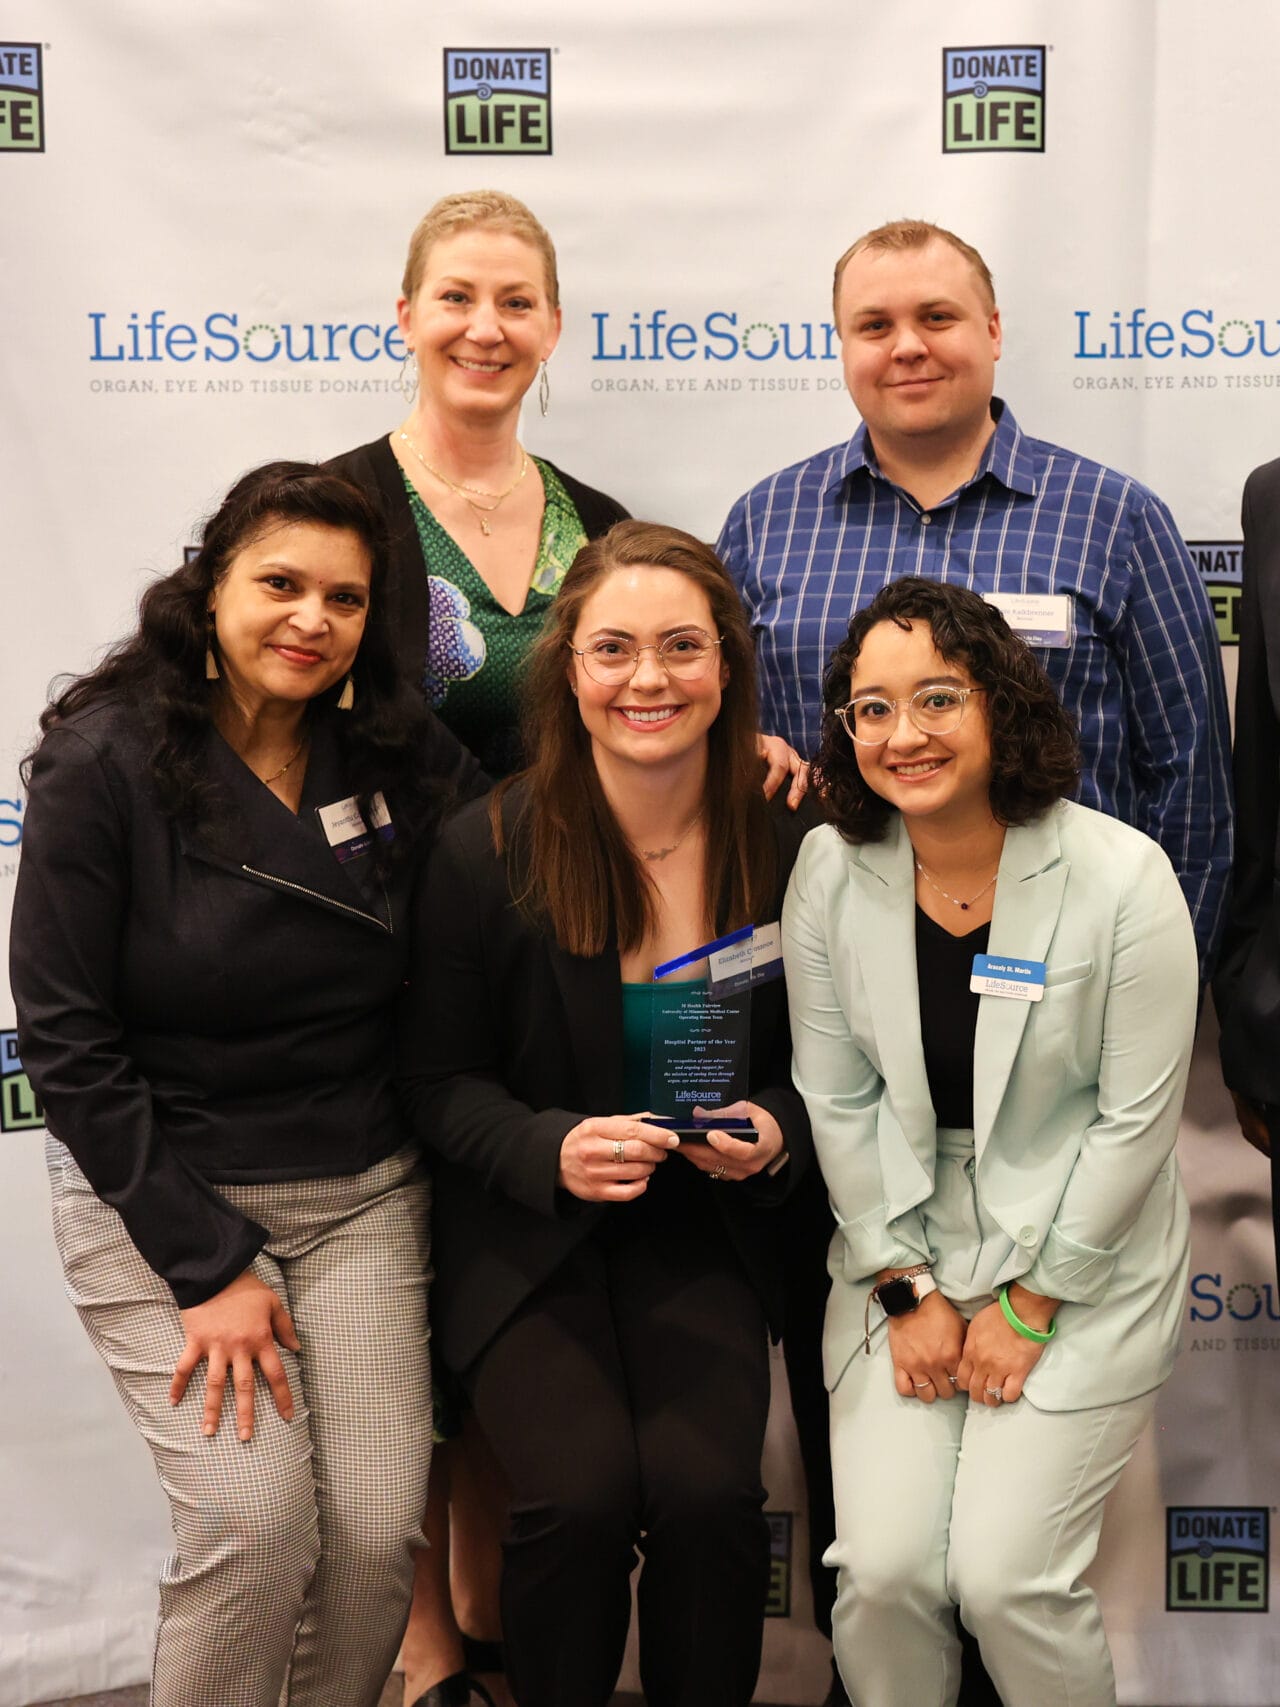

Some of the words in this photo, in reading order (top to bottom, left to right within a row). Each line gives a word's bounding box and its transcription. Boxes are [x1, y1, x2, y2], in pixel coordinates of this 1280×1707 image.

[454, 58, 542, 80] DONATE
[952, 55, 1037, 79] DONATE
[456, 104, 542, 144] LIFE
[953, 102, 1036, 142] LIFE
[88, 310, 405, 362] LifeSource
[90, 379, 159, 394] ORGAN,
[165, 379, 198, 393] EYE
[205, 379, 244, 393] AND
[250, 378, 314, 393] TISSUE
[320, 378, 418, 393] DONATION
[591, 379, 659, 393] ORGAN,
[666, 379, 697, 392] EYE
[704, 379, 742, 392] AND
[749, 378, 810, 391] TISSUE
[1073, 376, 1138, 390] ORGAN,
[1145, 376, 1174, 389] EYE
[1181, 376, 1218, 389] AND
[985, 979, 1028, 993] LifeSource
[675, 1090, 721, 1099] LifeSource
[1190, 1339, 1226, 1352] AND
[1176, 1516, 1262, 1539] DONATE
[1177, 1562, 1260, 1601] LIFE
